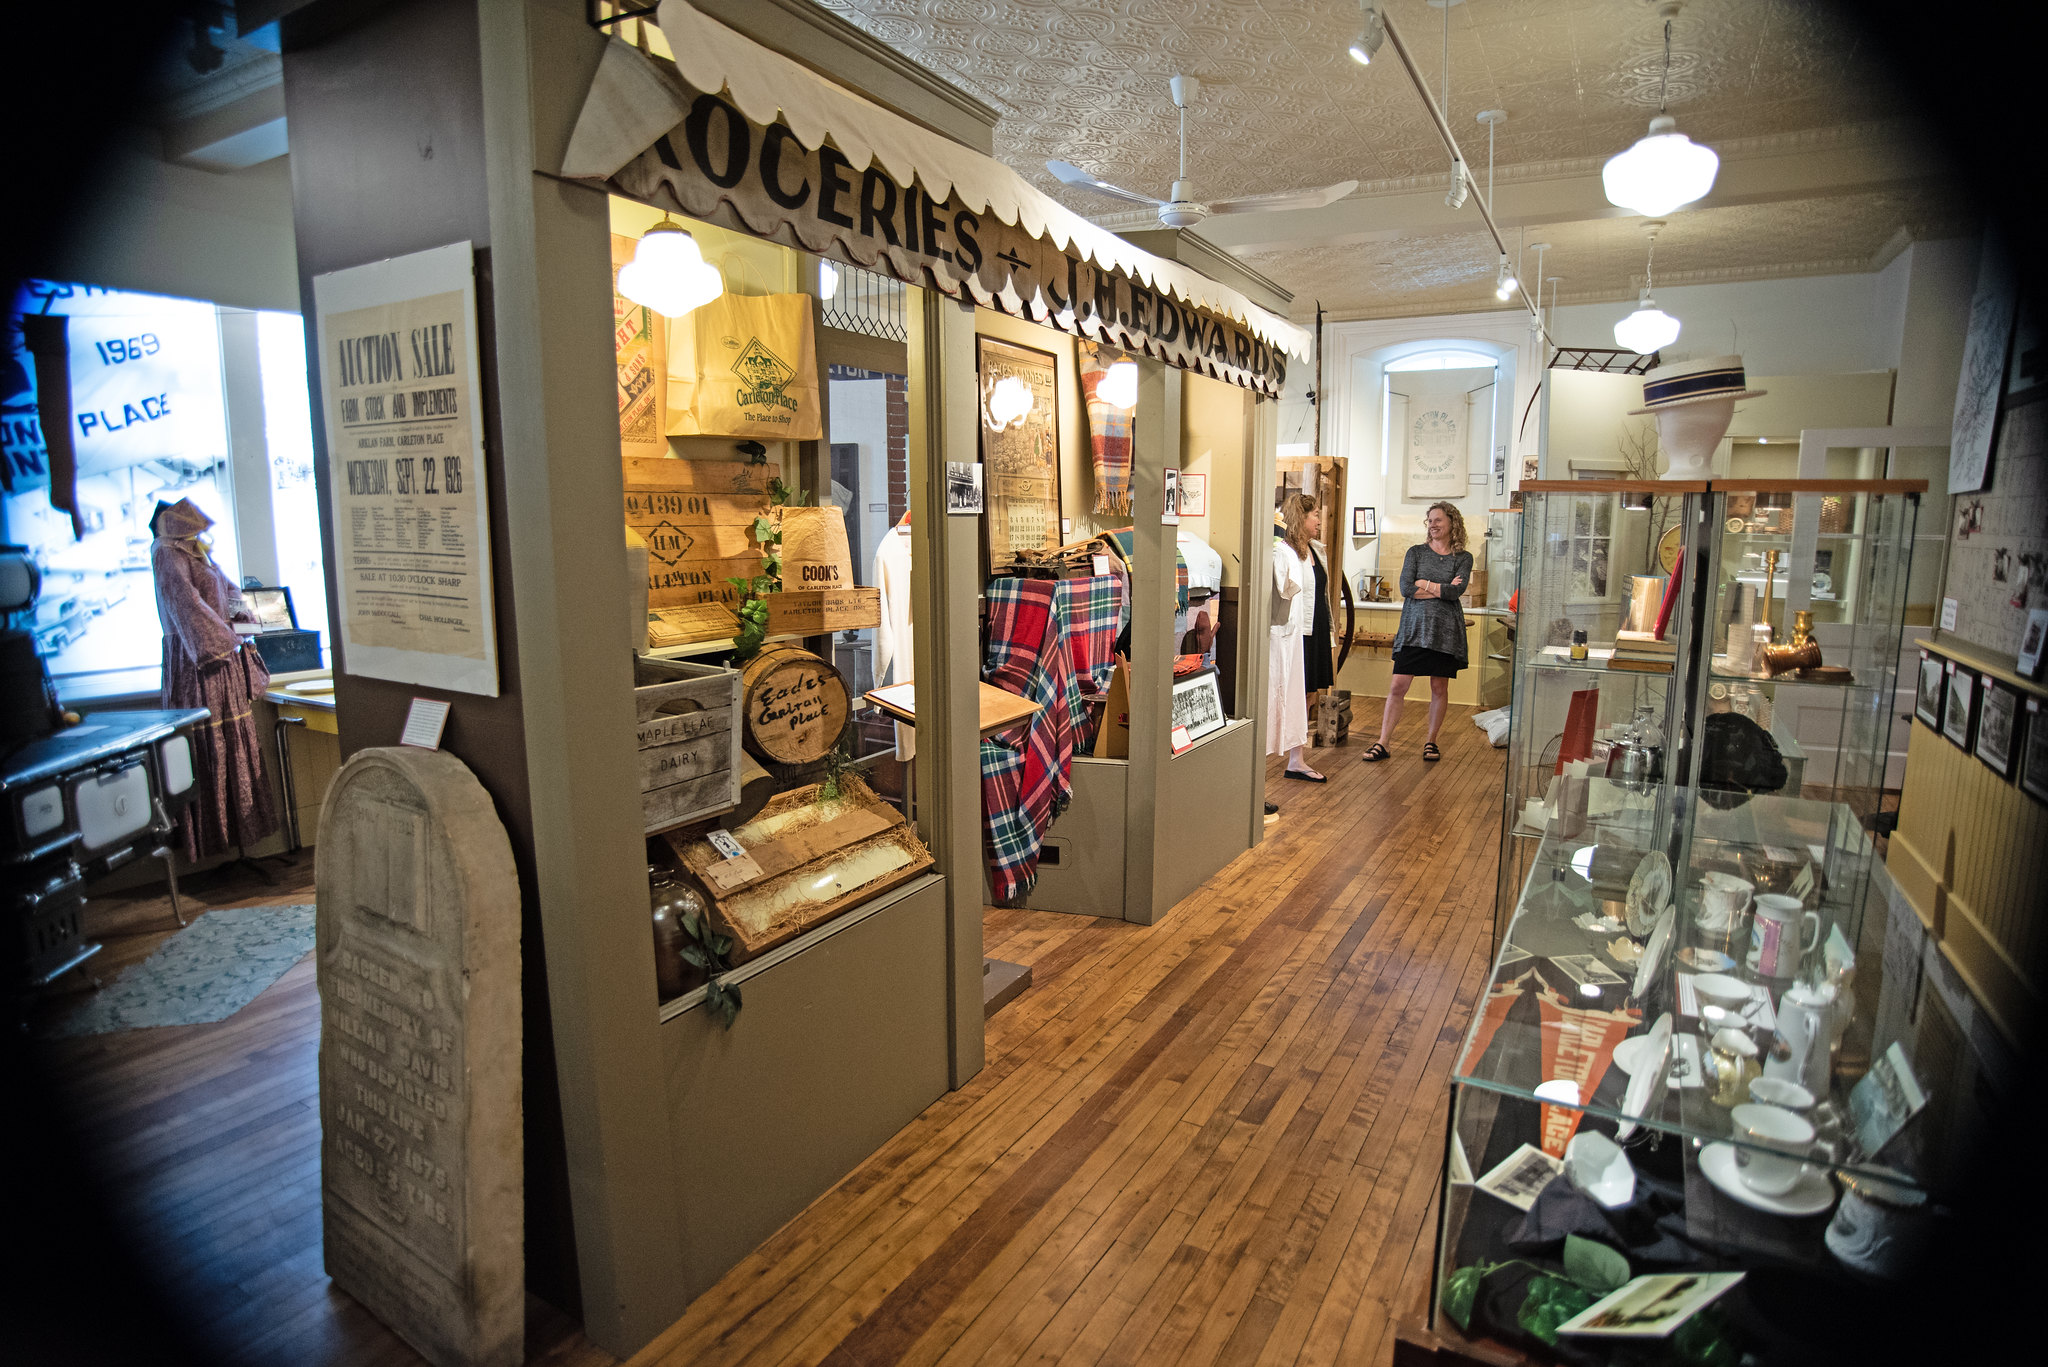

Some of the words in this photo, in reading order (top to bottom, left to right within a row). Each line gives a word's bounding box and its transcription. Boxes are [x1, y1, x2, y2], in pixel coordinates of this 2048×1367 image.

[96, 333, 160, 366] 1969
[339, 332, 403, 387] AUCTION
[411, 323, 455, 379] SALE
[78, 393, 172, 437] PLACE
[341, 398, 360, 423] FARM
[365, 395, 386, 421] STOCK
[393, 392, 407, 419] AND
[412, 387, 458, 417] IMPLEMENTS
[744, 412, 756, 421] The
[756, 413, 772, 423] Place
[778, 414, 792, 426] Shop
[397, 434, 426, 446] CARLETON
[427, 433, 445, 444] PLACE
[396, 457, 419, 496] SEPT.
[378, 573, 387, 582] AT
[437, 578, 462, 588] SHARP
[802, 564, 839, 582] COOK'S
[637, 723, 678, 743] MAPLE
[683, 715, 714, 736] LEAF
[660, 750, 699, 772] DAIRY
